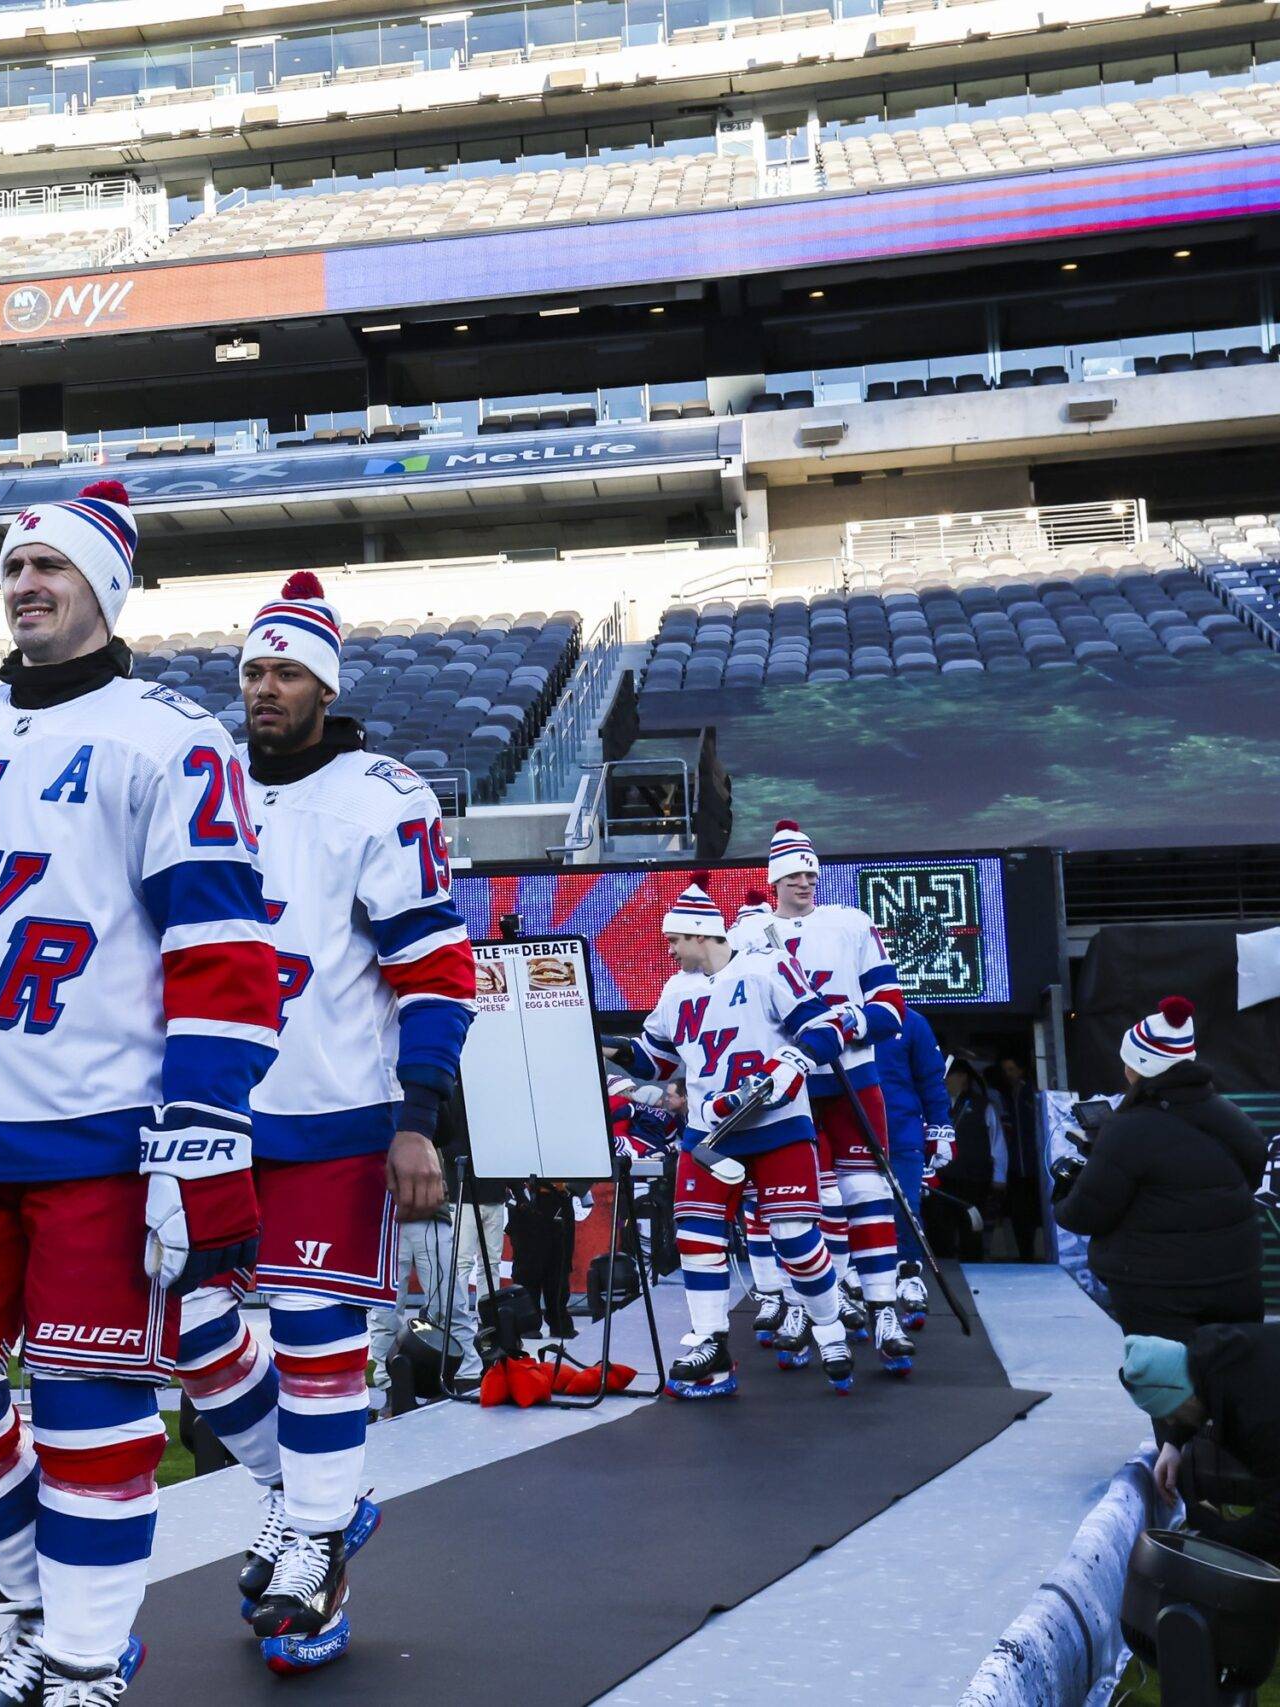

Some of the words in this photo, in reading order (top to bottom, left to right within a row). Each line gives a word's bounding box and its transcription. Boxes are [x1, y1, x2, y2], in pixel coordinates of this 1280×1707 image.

[445, 442, 637, 467] MetLife
[40, 745, 94, 804] A
[183, 745, 259, 855] 20
[397, 817, 451, 899] 79
[502, 947, 520, 956] THE
[522, 942, 579, 957] DEBATE
[525, 991, 559, 1000] TAYLOR
[525, 1001, 543, 1009] EGG
[552, 999, 585, 1008] CHEESE
[729, 979, 747, 1007] A
[765, 1185, 807, 1196] CCM
